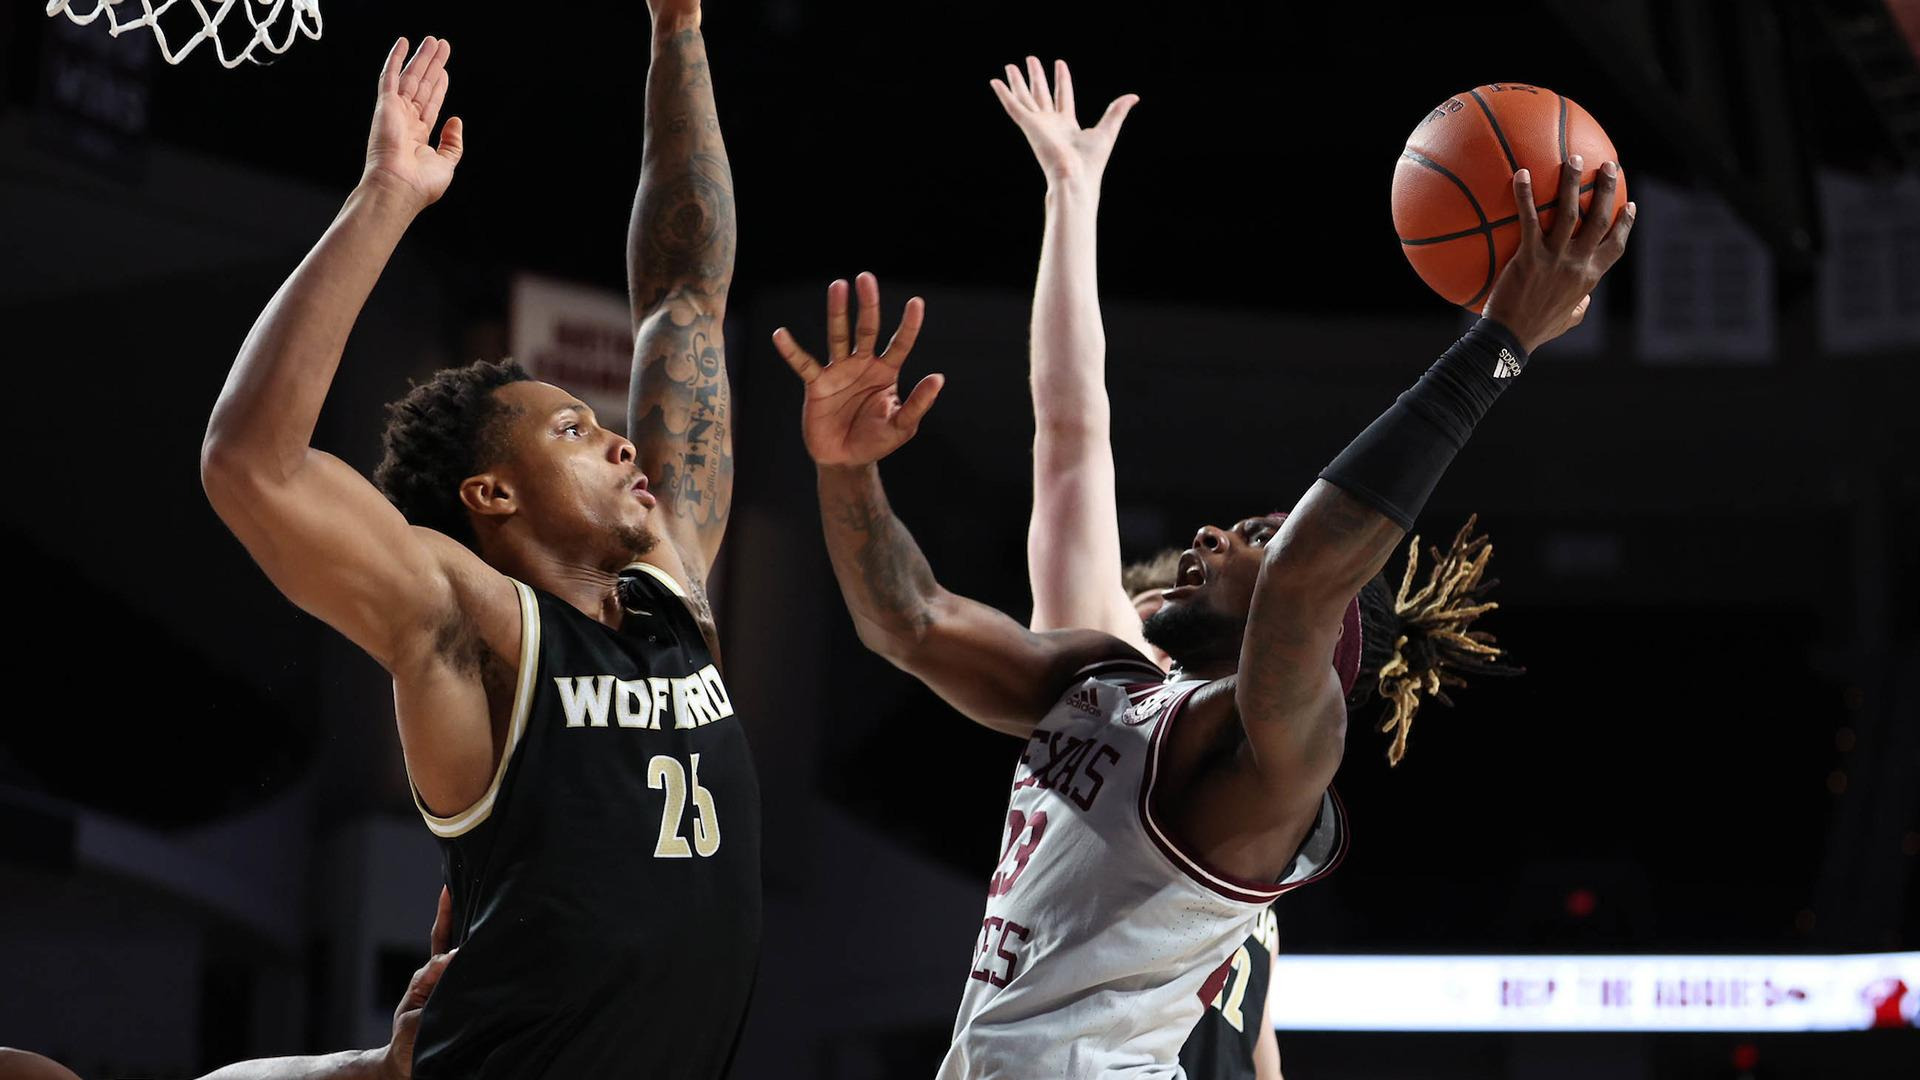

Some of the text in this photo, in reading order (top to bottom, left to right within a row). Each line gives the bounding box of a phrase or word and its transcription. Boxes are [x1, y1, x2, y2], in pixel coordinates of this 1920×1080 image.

[553, 663, 735, 730] WOFRD
[1065, 697, 1102, 718] adidas
[647, 753, 721, 858] 25
[1014, 729, 1121, 812] EXAS
